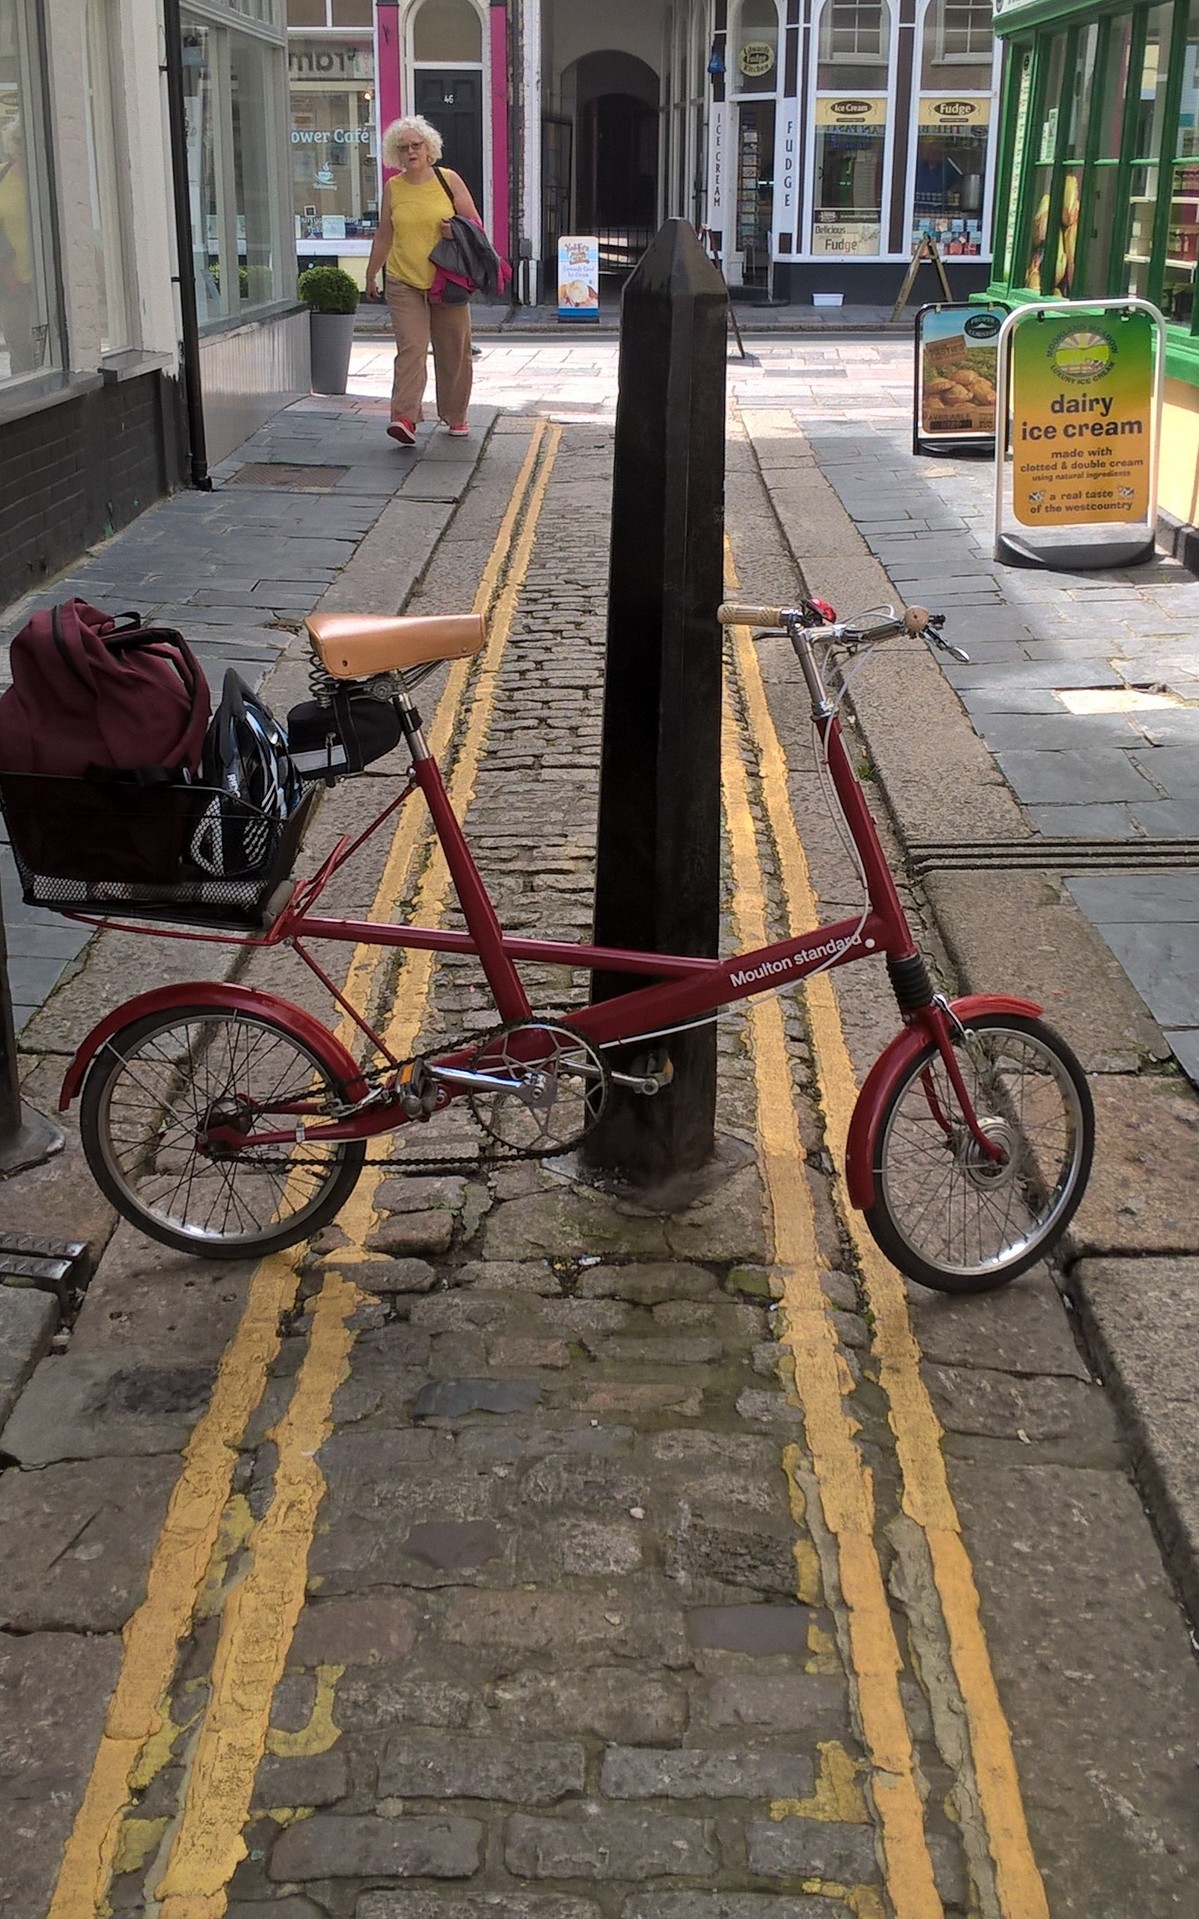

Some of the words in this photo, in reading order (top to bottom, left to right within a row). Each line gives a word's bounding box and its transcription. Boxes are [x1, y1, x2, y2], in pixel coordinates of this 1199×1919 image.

[834, 103, 845, 112] Ice
[845, 103, 868, 112] Cream
[939, 102, 972, 115] Fudge
[333, 127, 369, 143] Café
[783, 120, 794, 207] FUDGE
[713, 151, 722, 207] CREAM
[814, 225, 847, 235] Delicious
[824, 238, 858, 253] Fudge
[1050, 364, 1076, 384] LUXURY
[1093, 361, 1116, 382] CREAM
[1051, 393, 1114, 417] dairy
[1021, 421, 1058, 441] ice
[1063, 420, 1143, 438] cream
[1051, 448, 1084, 459] made
[1087, 447, 1113, 457] with
[1020, 462, 1058, 472] clotted
[1061, 461, 1068, 470] &
[1071, 460, 1106, 469] double
[1109, 459, 1144, 468] cream
[1032, 474, 1053, 482] using
[1055, 472, 1085, 480] natural
[1086, 470, 1131, 480] ingredients
[1061, 490, 1082, 500] real
[1085, 489, 1114, 499] taste
[1030, 504, 1042, 514] of
[1045, 503, 1062, 513] the
[1065, 501, 1133, 512] westcountry
[729, 956, 793, 988] Moulton
